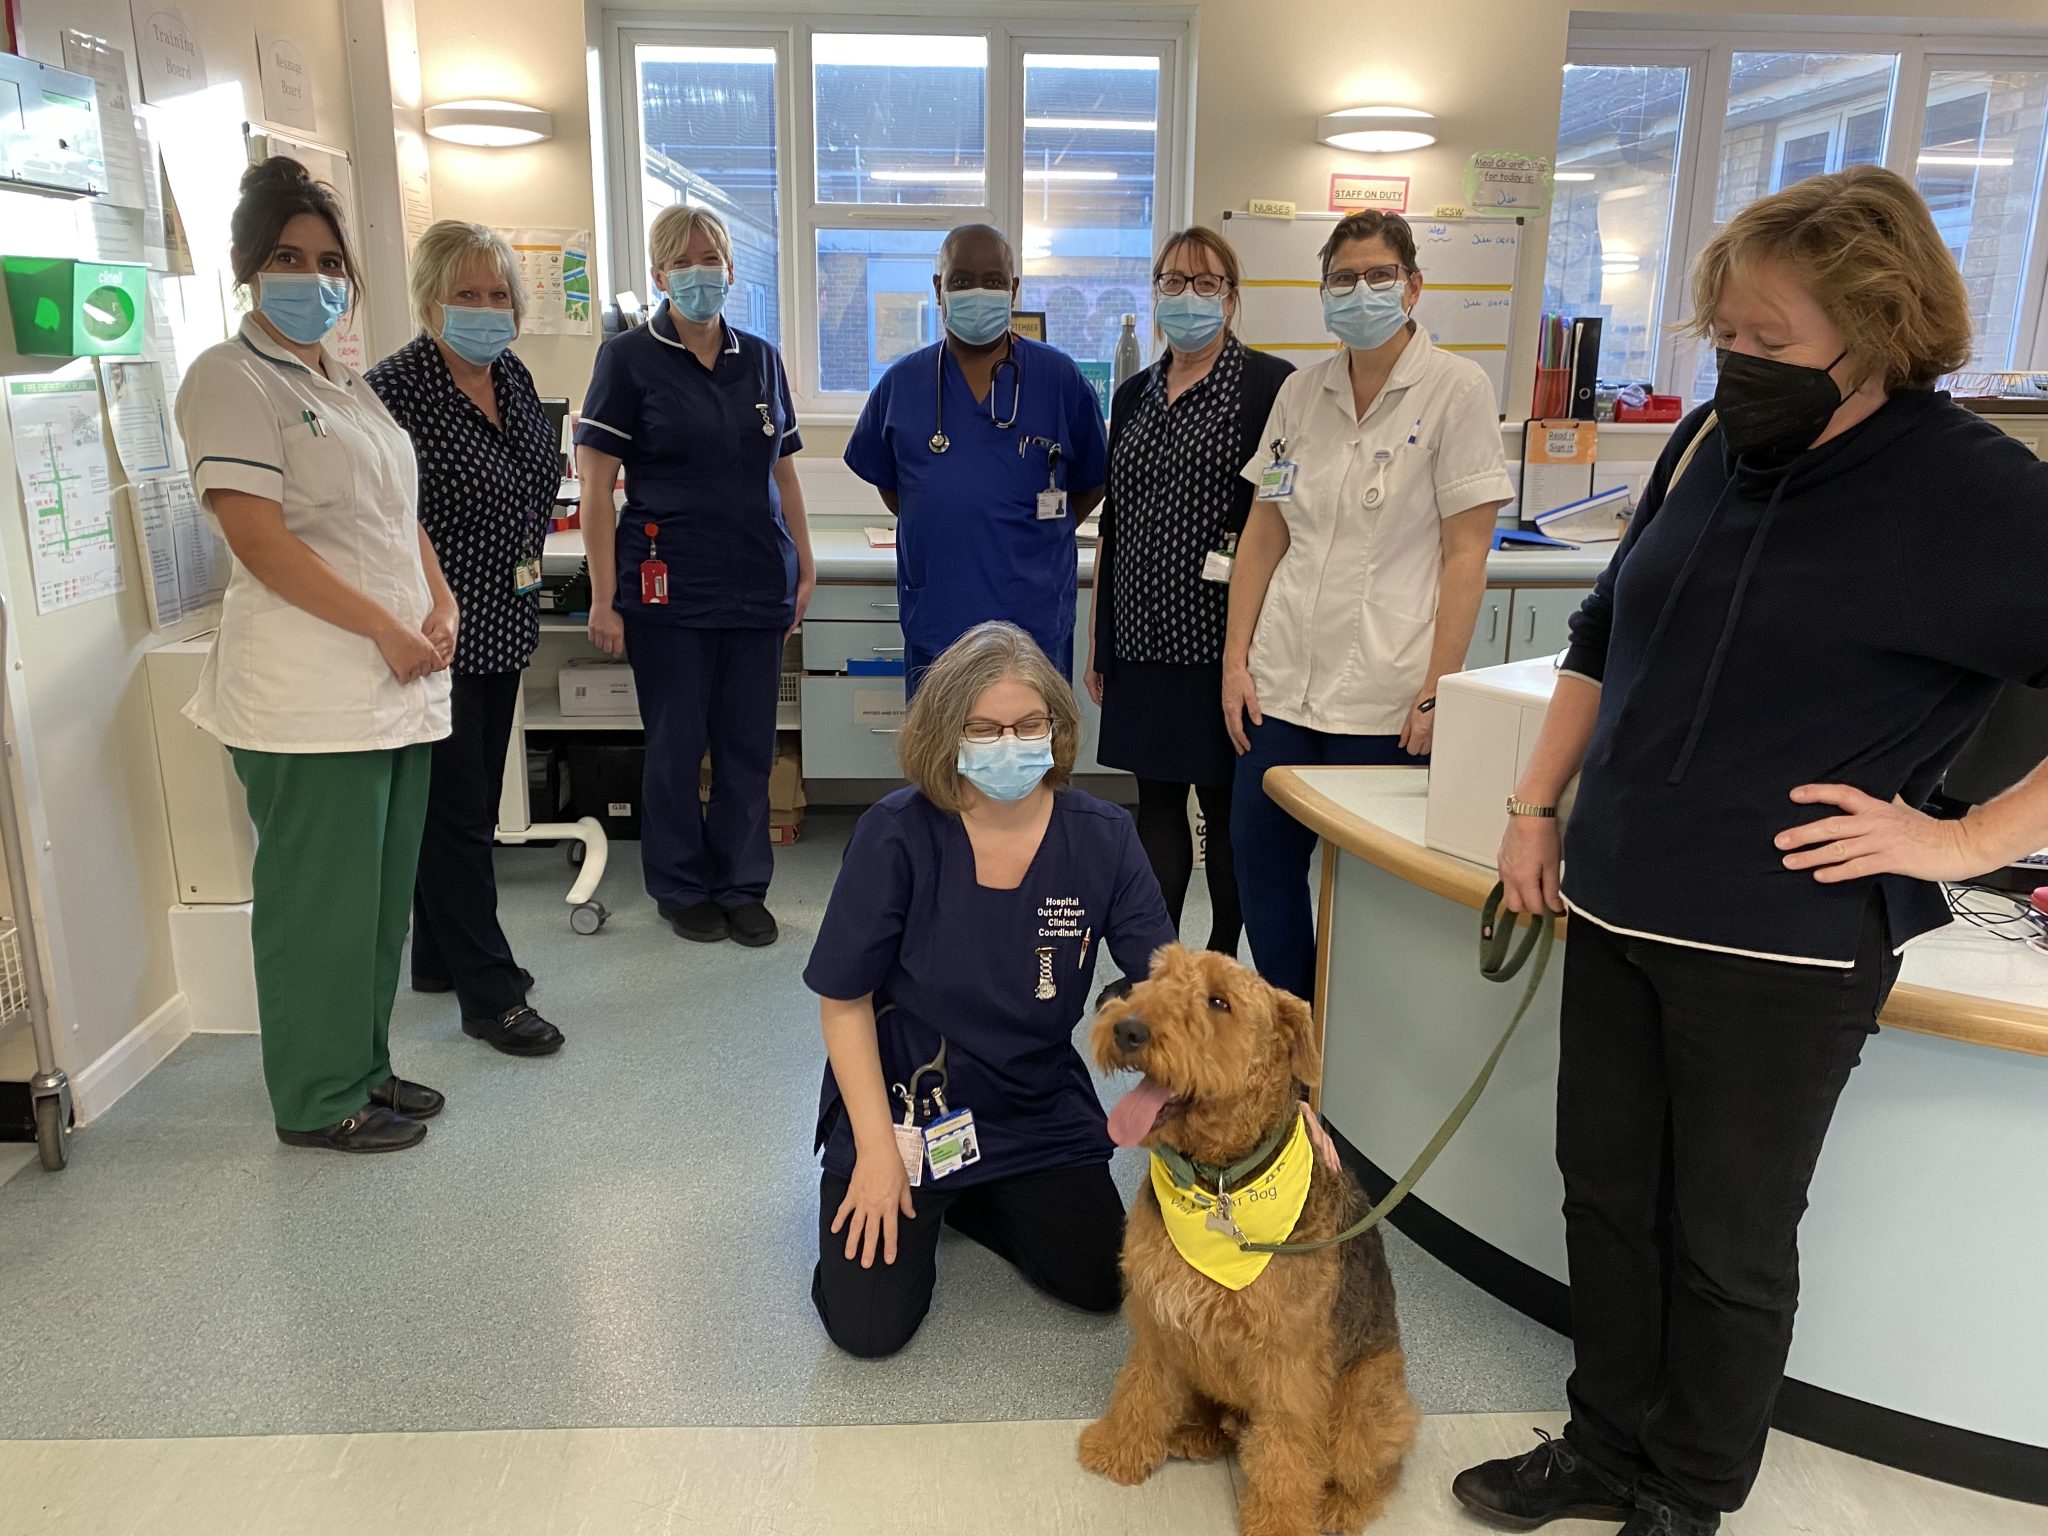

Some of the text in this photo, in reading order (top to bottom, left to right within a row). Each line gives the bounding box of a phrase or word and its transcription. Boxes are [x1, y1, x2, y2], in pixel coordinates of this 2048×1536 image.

[152, 24, 196, 56] Training
[165, 56, 192, 80] Board
[274, 51, 303, 75] Message
[281, 79, 303, 98] Board
[1500, 173, 1522, 183] today
[1334, 189, 1403, 200] STAFF ON DUTY
[1254, 203, 1290, 215] NURSES
[1436, 208, 1465, 217] HCSW
[23, 383, 38, 393] FIRE
[1548, 431, 1576, 441] Read it
[1549, 443, 1574, 453] Sign it
[1045, 897, 1079, 907] Hospital
[1037, 908, 1053, 916] Out
[1053, 908, 1063, 916] of
[1048, 918, 1077, 927] Clinical
[1249, 1186, 1277, 1202] dog
